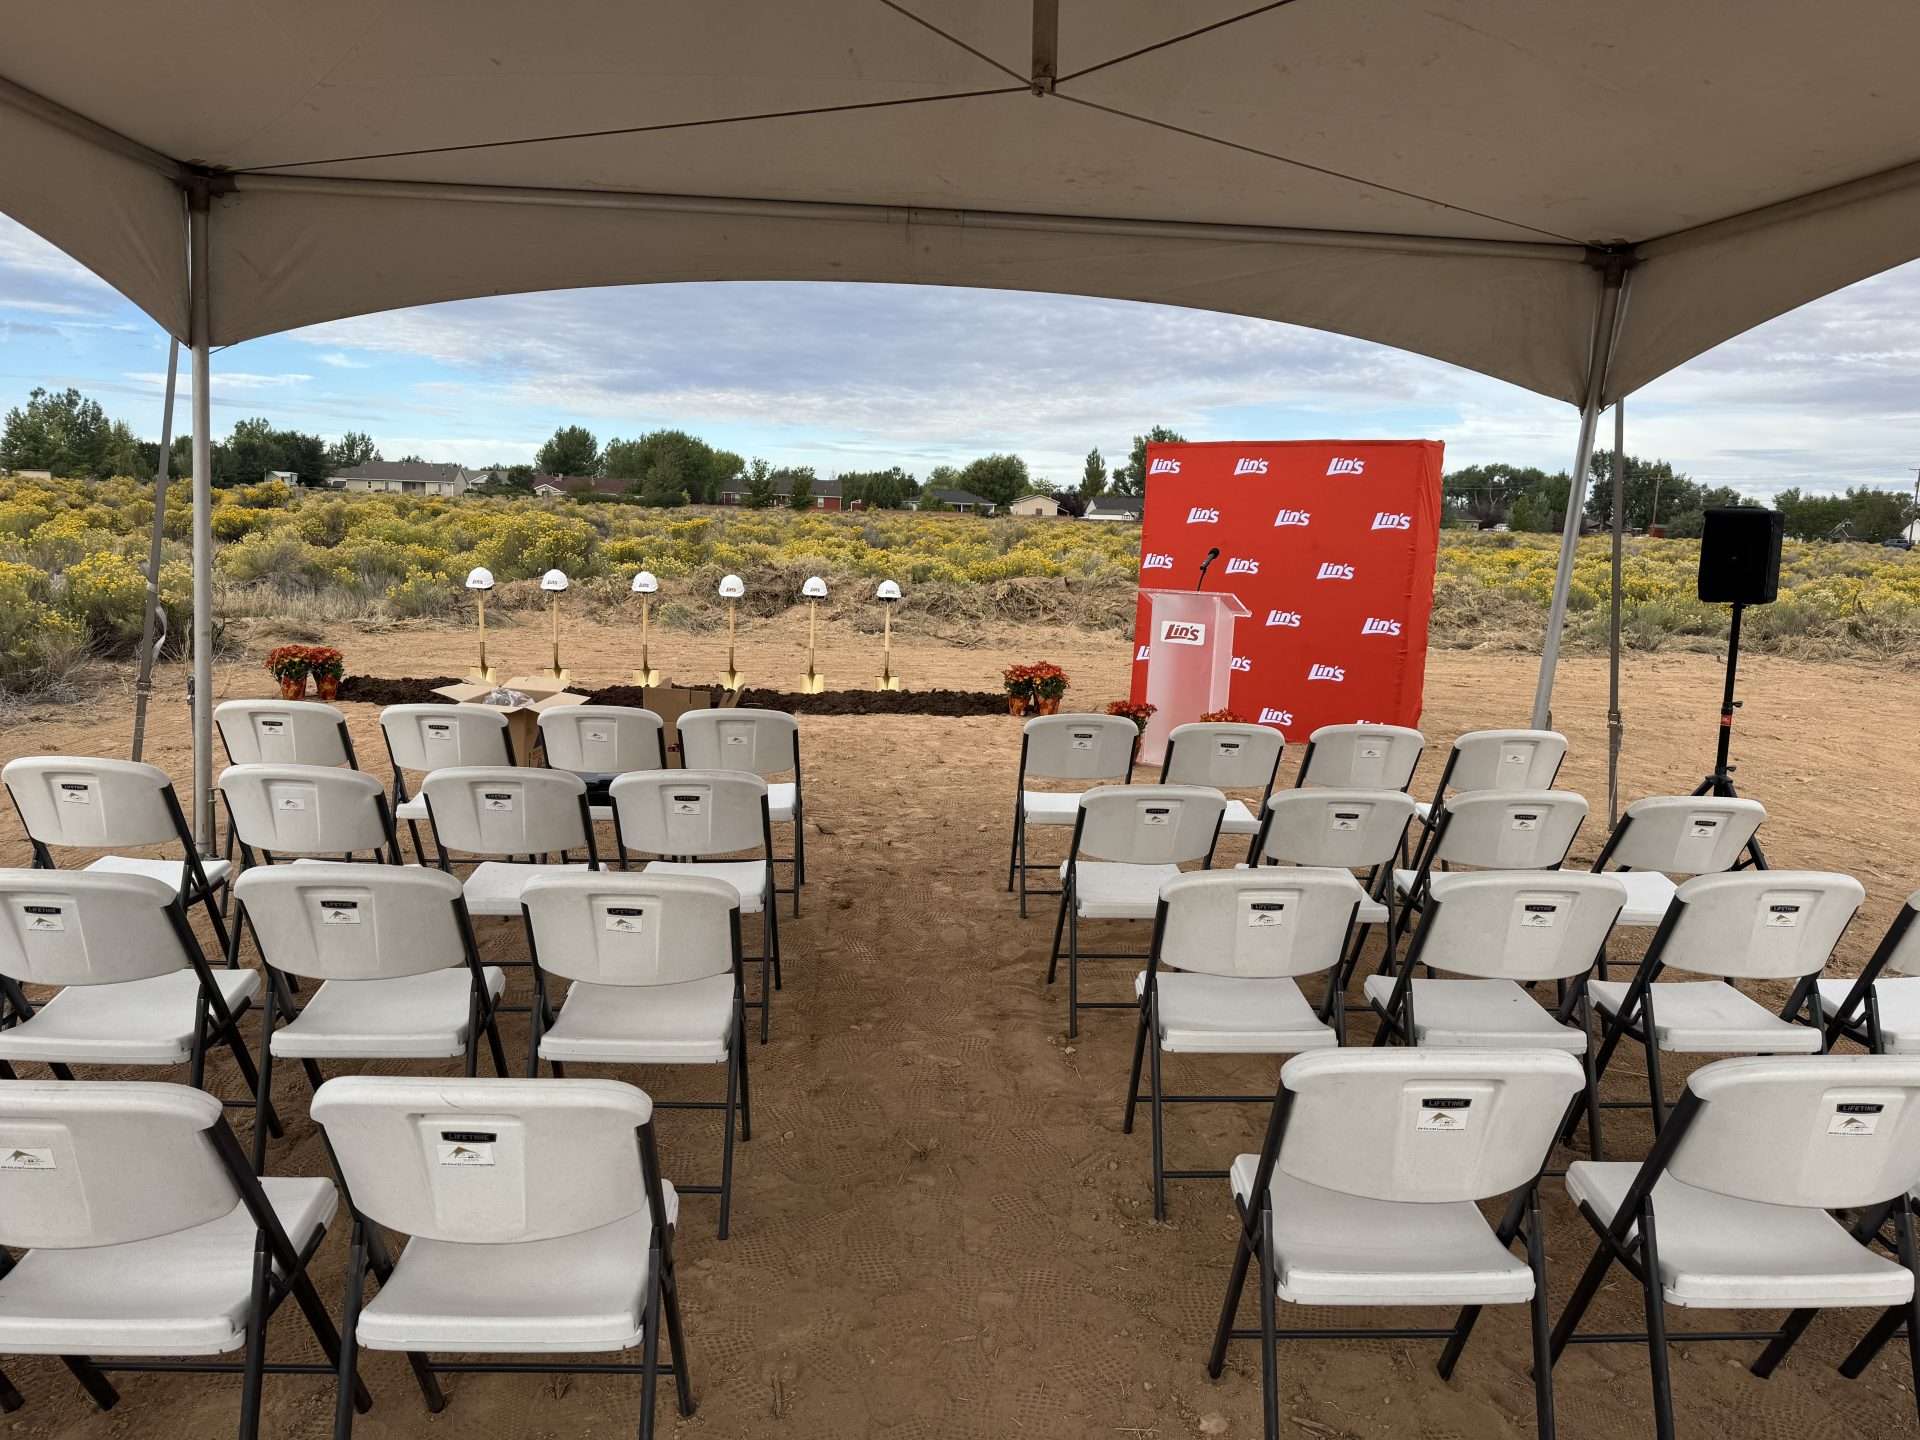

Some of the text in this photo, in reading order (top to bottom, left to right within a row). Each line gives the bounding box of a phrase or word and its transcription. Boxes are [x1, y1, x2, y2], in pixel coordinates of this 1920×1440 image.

[1150, 458, 1181, 474] Lin's
[1234, 458, 1269, 475] Lin's
[1326, 457, 1365, 476] Lin's
[1187, 508, 1219, 524] Lin's
[1274, 509, 1311, 527] Lin's
[1371, 512, 1411, 531] Lin's
[1143, 553, 1174, 569] Lin's
[1225, 558, 1260, 575] Lin's
[1317, 562, 1355, 580] Lin's
[1265, 609, 1302, 628] Lin's
[1361, 617, 1402, 636] Lin's
[1164, 623, 1200, 641] Lin's
[1231, 655, 1252, 672] n's
[1307, 663, 1346, 682] Lin's
[1258, 707, 1293, 727] Lin's
